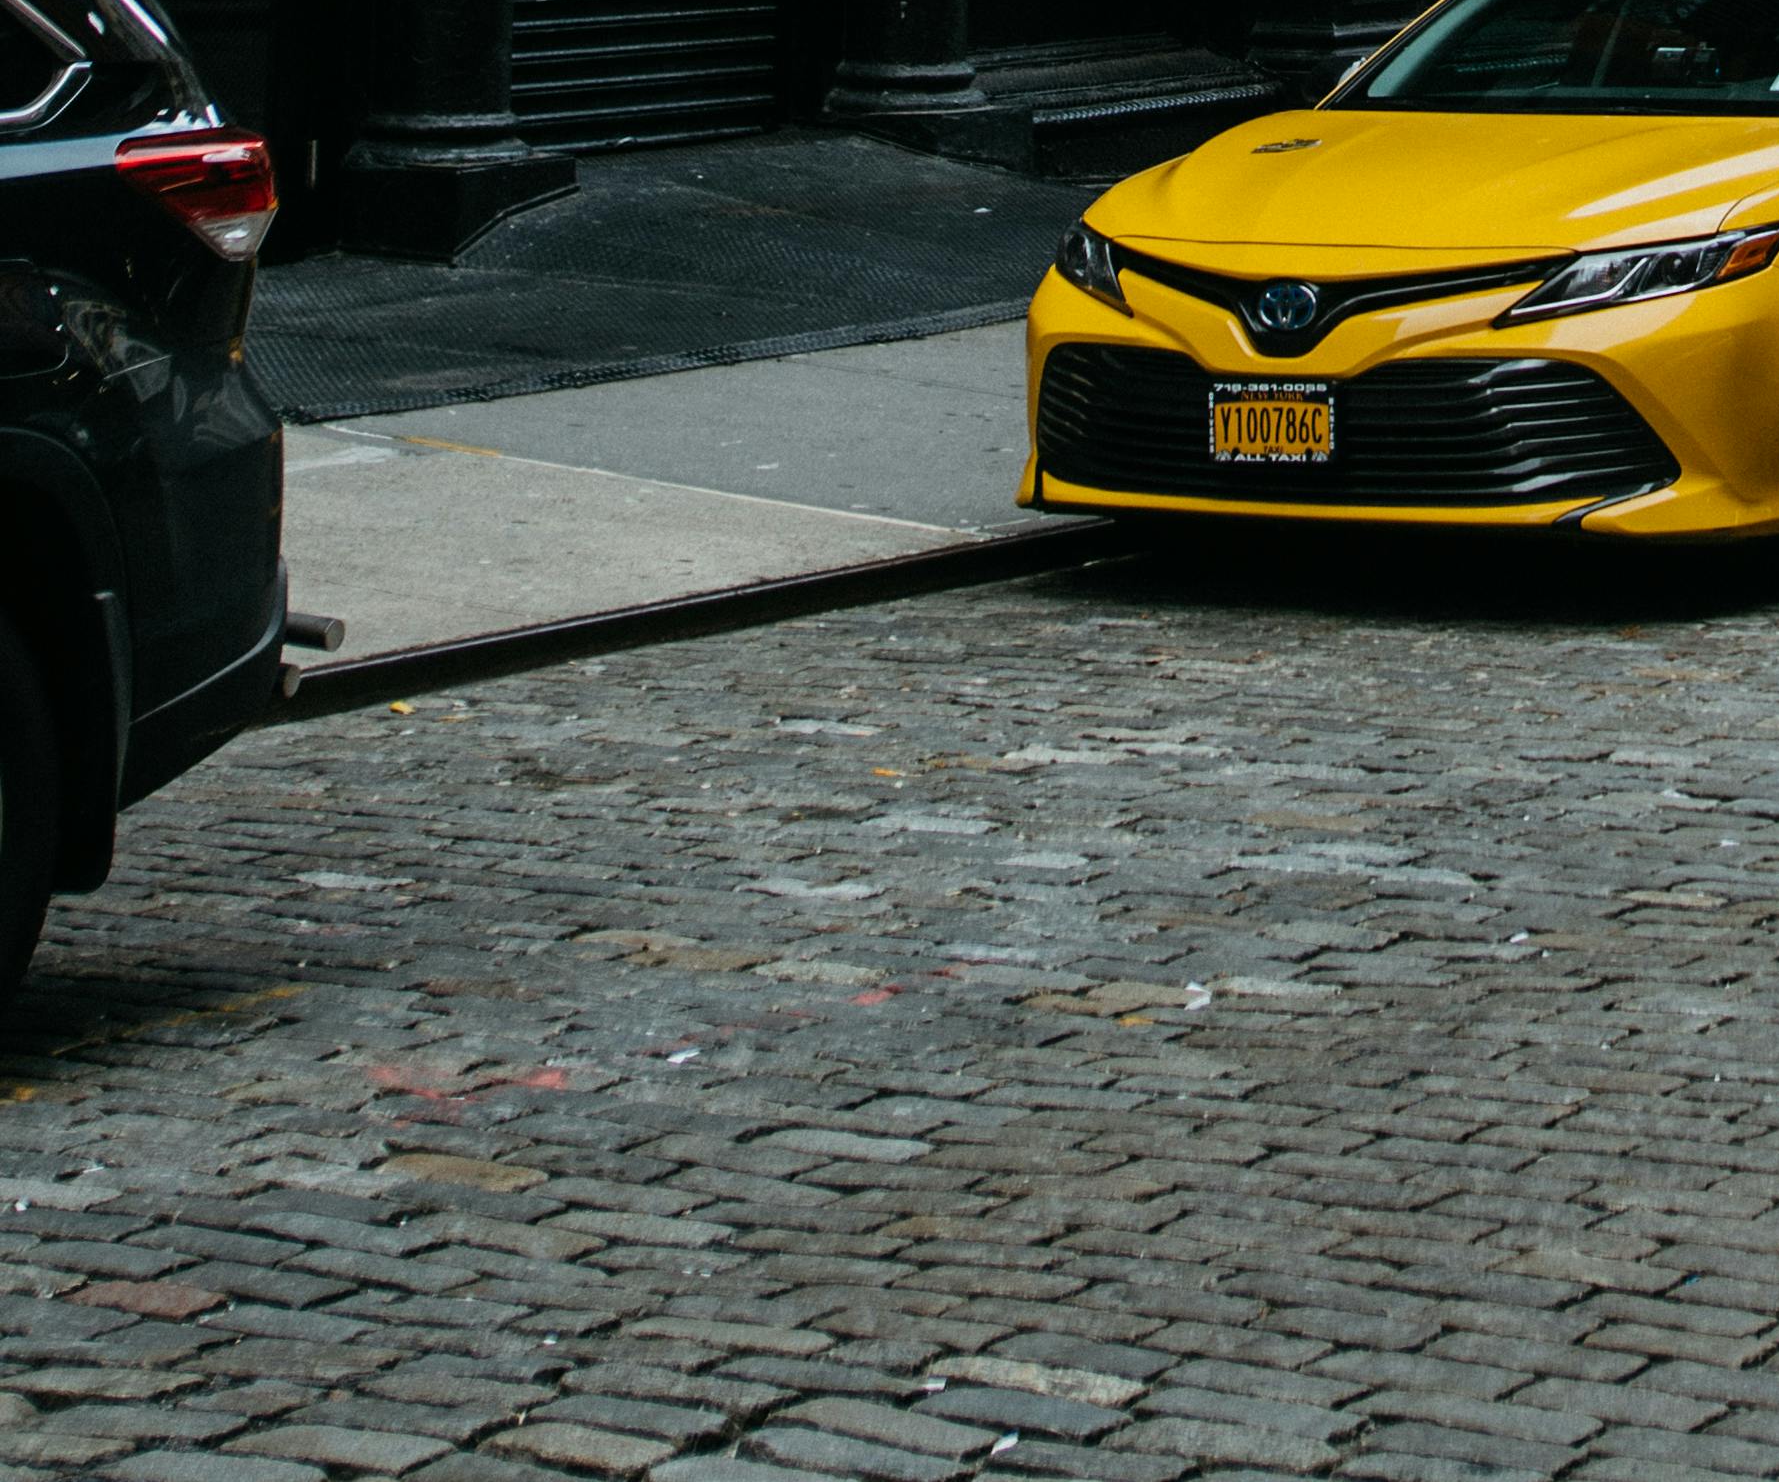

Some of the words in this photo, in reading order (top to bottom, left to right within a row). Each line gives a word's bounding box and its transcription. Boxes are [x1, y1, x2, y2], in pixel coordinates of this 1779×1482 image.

[1220, 406, 1322, 444] Y100786C
[1233, 453, 1266, 462] ALL
[1268, 453, 1306, 462] TAXI
